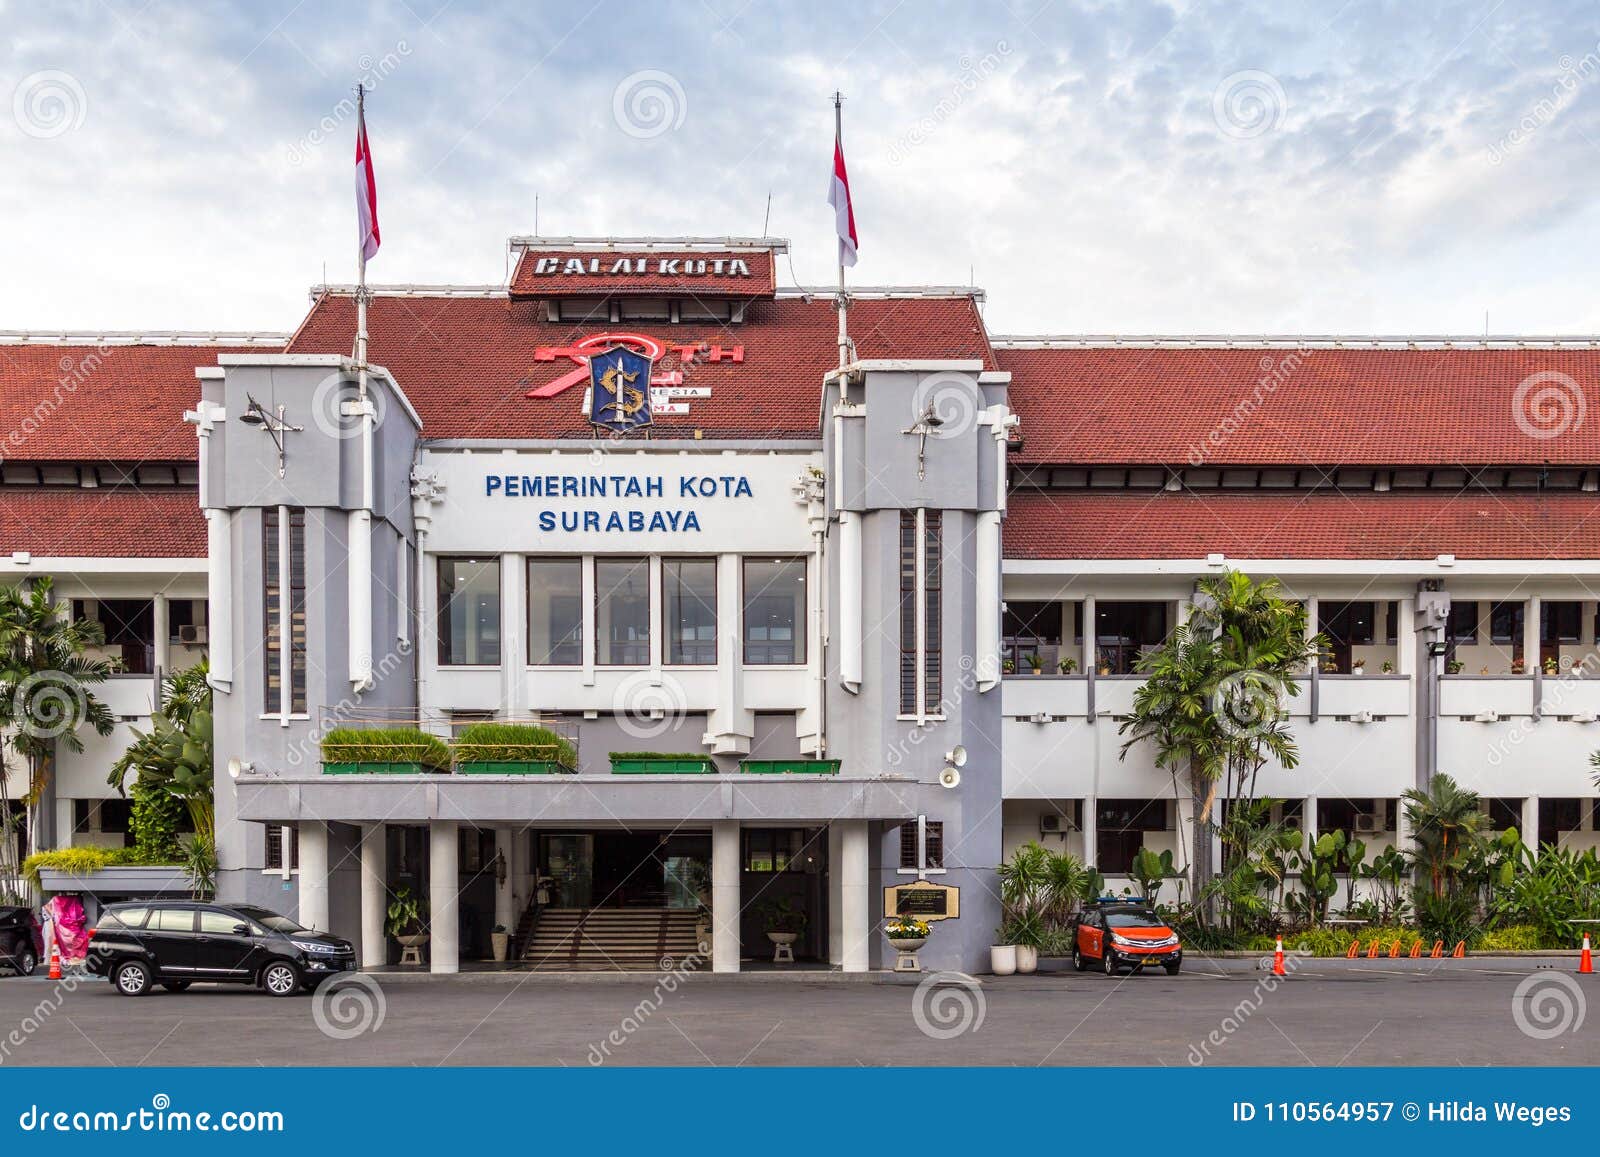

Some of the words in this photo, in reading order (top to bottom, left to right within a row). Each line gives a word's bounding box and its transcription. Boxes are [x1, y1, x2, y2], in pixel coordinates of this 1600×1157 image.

[486, 475, 663, 498] PEMERINTAH
[680, 475, 754, 498] KOTA
[538, 510, 701, 532] SURABAYA
